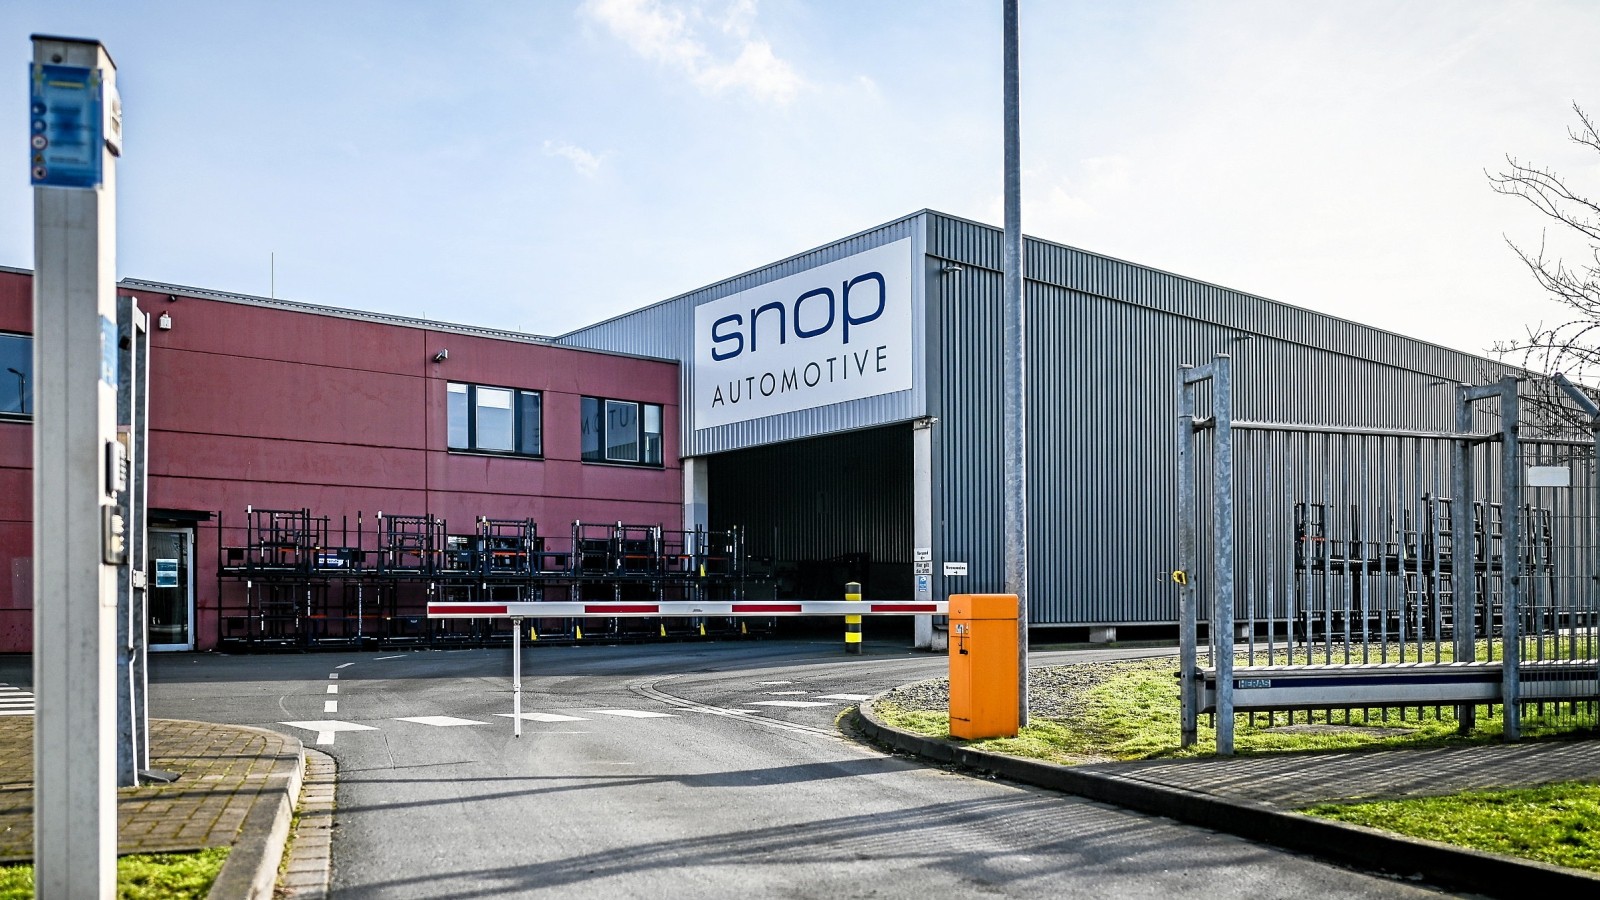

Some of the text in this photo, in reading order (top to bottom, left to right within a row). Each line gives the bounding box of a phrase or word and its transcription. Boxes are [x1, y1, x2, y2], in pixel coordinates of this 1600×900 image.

[711, 271, 886, 362] snop
[711, 345, 887, 408] AUTOMOTIVE
[1240, 679, 1270, 688] HERAS
